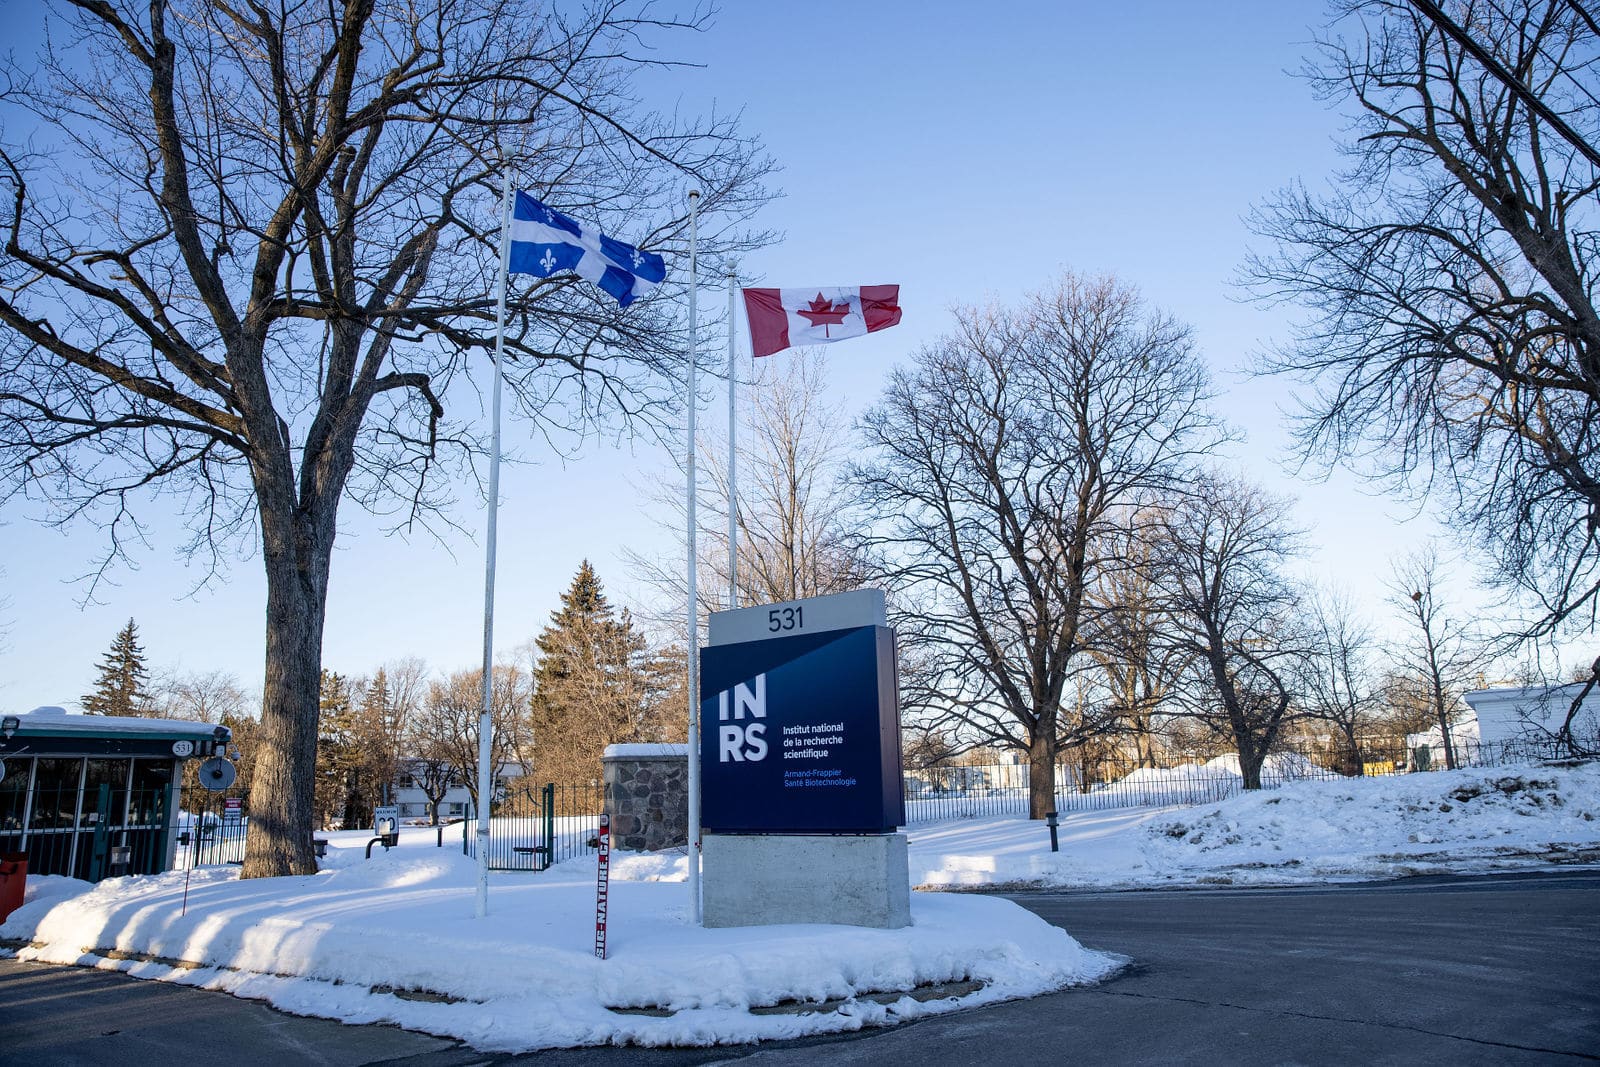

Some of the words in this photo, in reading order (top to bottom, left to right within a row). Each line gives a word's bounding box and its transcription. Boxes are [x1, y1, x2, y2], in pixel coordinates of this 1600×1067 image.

[768, 606, 803, 632] 531
[719, 672, 767, 720] IN
[783, 724, 810, 735] Institut
[811, 722, 844, 733] national
[719, 722, 768, 763] RS
[783, 738, 793, 747] de
[795, 737, 802, 746] la
[803, 735, 843, 746] recherche
[176, 744, 190, 753] 531
[783, 748, 829, 760] scientifique
[784, 769, 842, 777] Armand-Frappier
[784, 779, 804, 787] Santé
[805, 777, 857, 787] Biotechnologie
[596, 833, 609, 959] SIG-NATURE.CA
